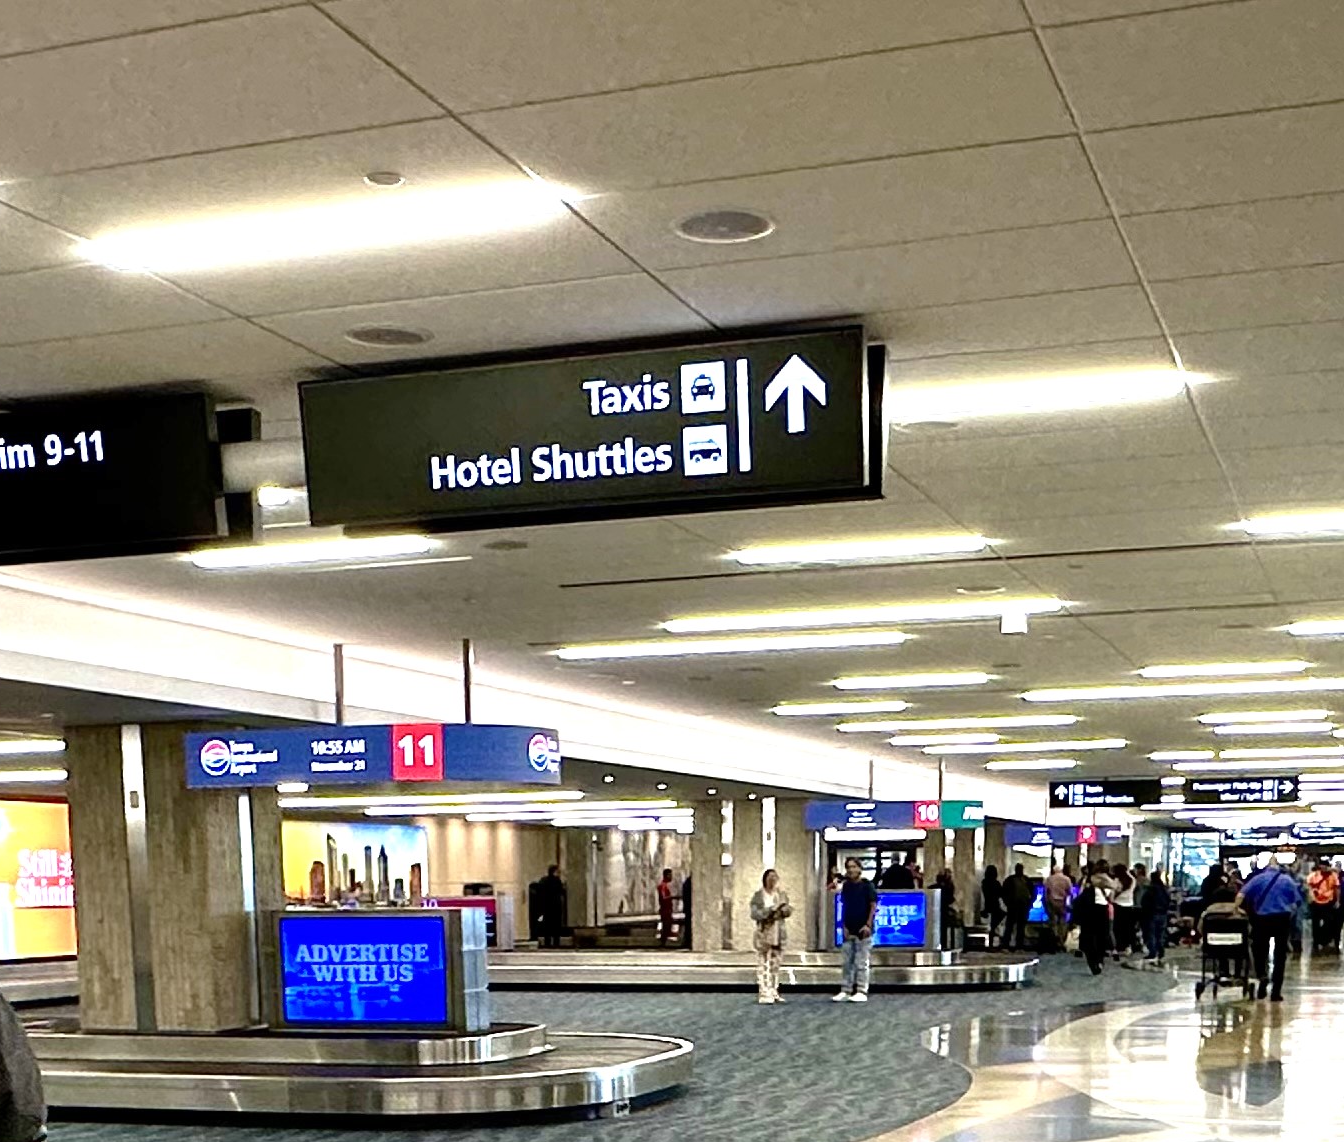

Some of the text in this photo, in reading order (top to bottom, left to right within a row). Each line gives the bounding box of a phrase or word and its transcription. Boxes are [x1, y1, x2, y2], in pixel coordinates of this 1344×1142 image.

[581, 373, 670, 416] Taxis
[44, 430, 104, 466] 9-11
[430, 436, 673, 490] Hotel Shuttles
[397, 734, 434, 766] 11
[917, 804, 939, 821] 10
[17, 849, 57, 877] Still
[295, 943, 430, 962] ADVERTISE
[311, 964, 414, 982] WITH US
